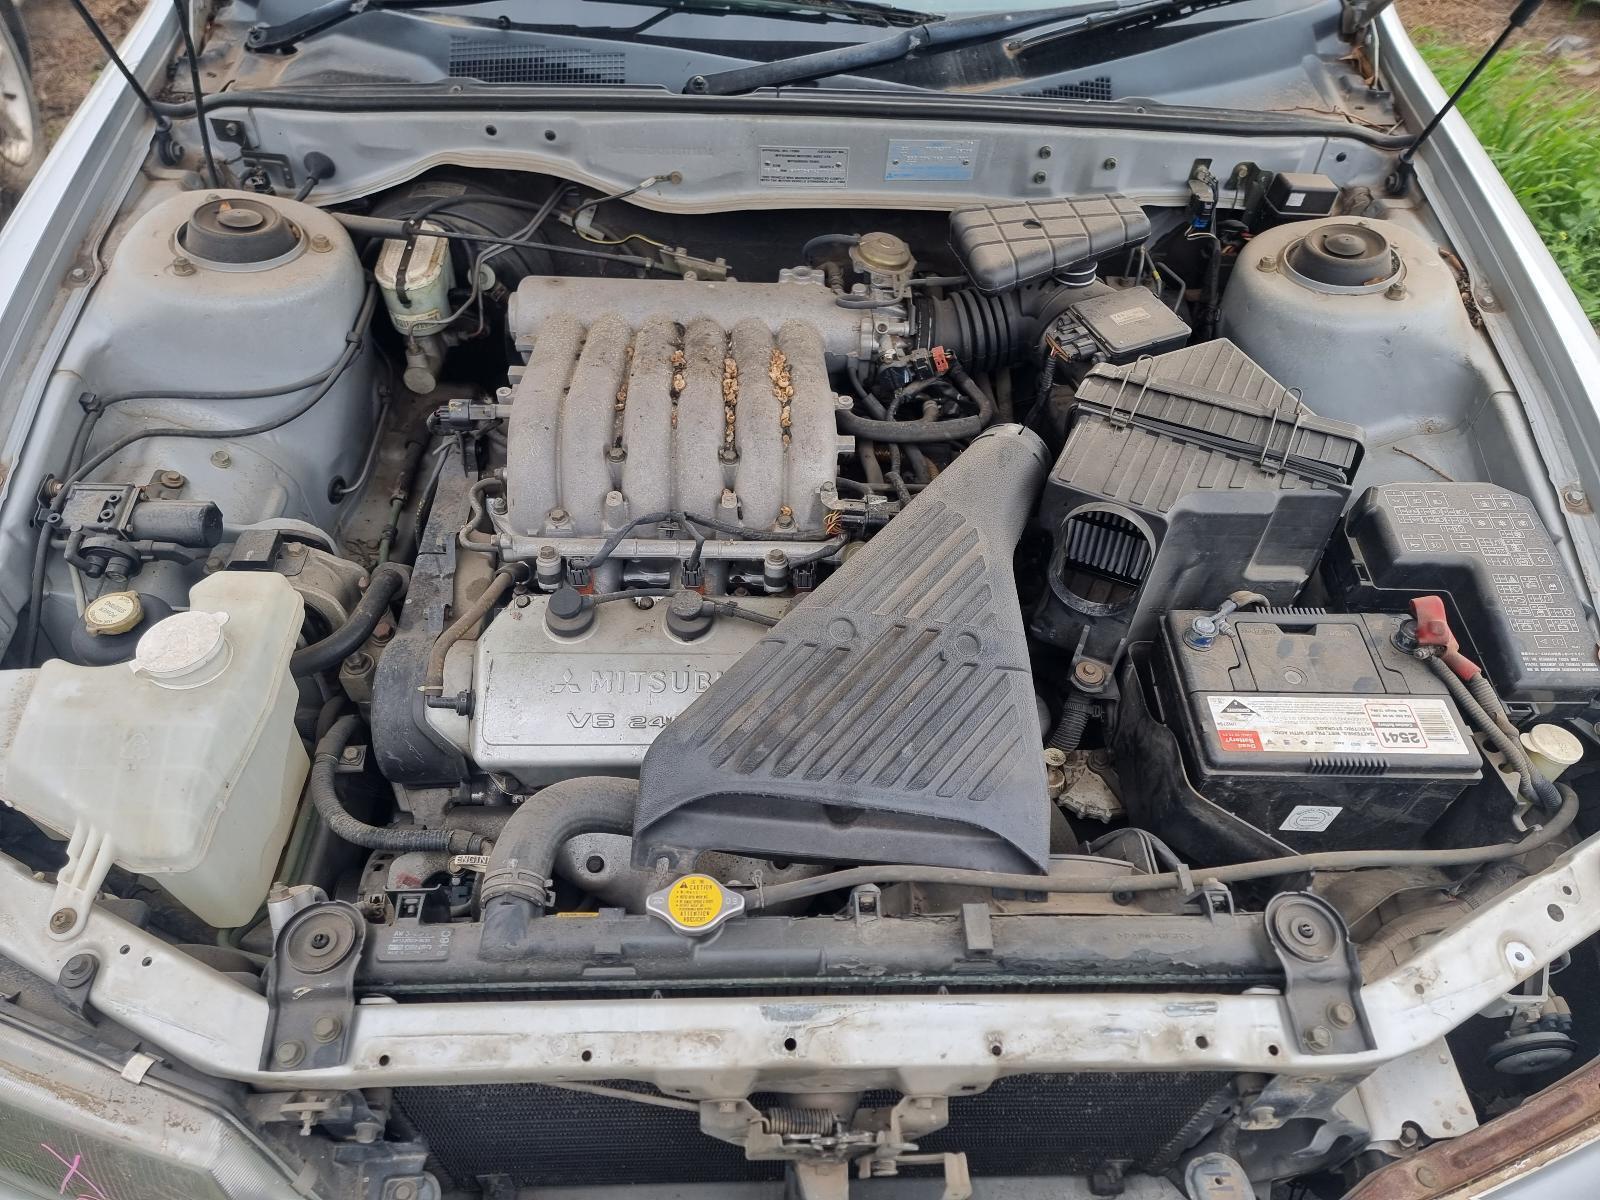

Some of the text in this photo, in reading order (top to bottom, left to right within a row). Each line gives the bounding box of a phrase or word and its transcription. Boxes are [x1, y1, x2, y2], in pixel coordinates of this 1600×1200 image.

[590, 670, 723, 694] MITSUB
[566, 712, 615, 729] V6
[1381, 731, 1421, 744] 2541
